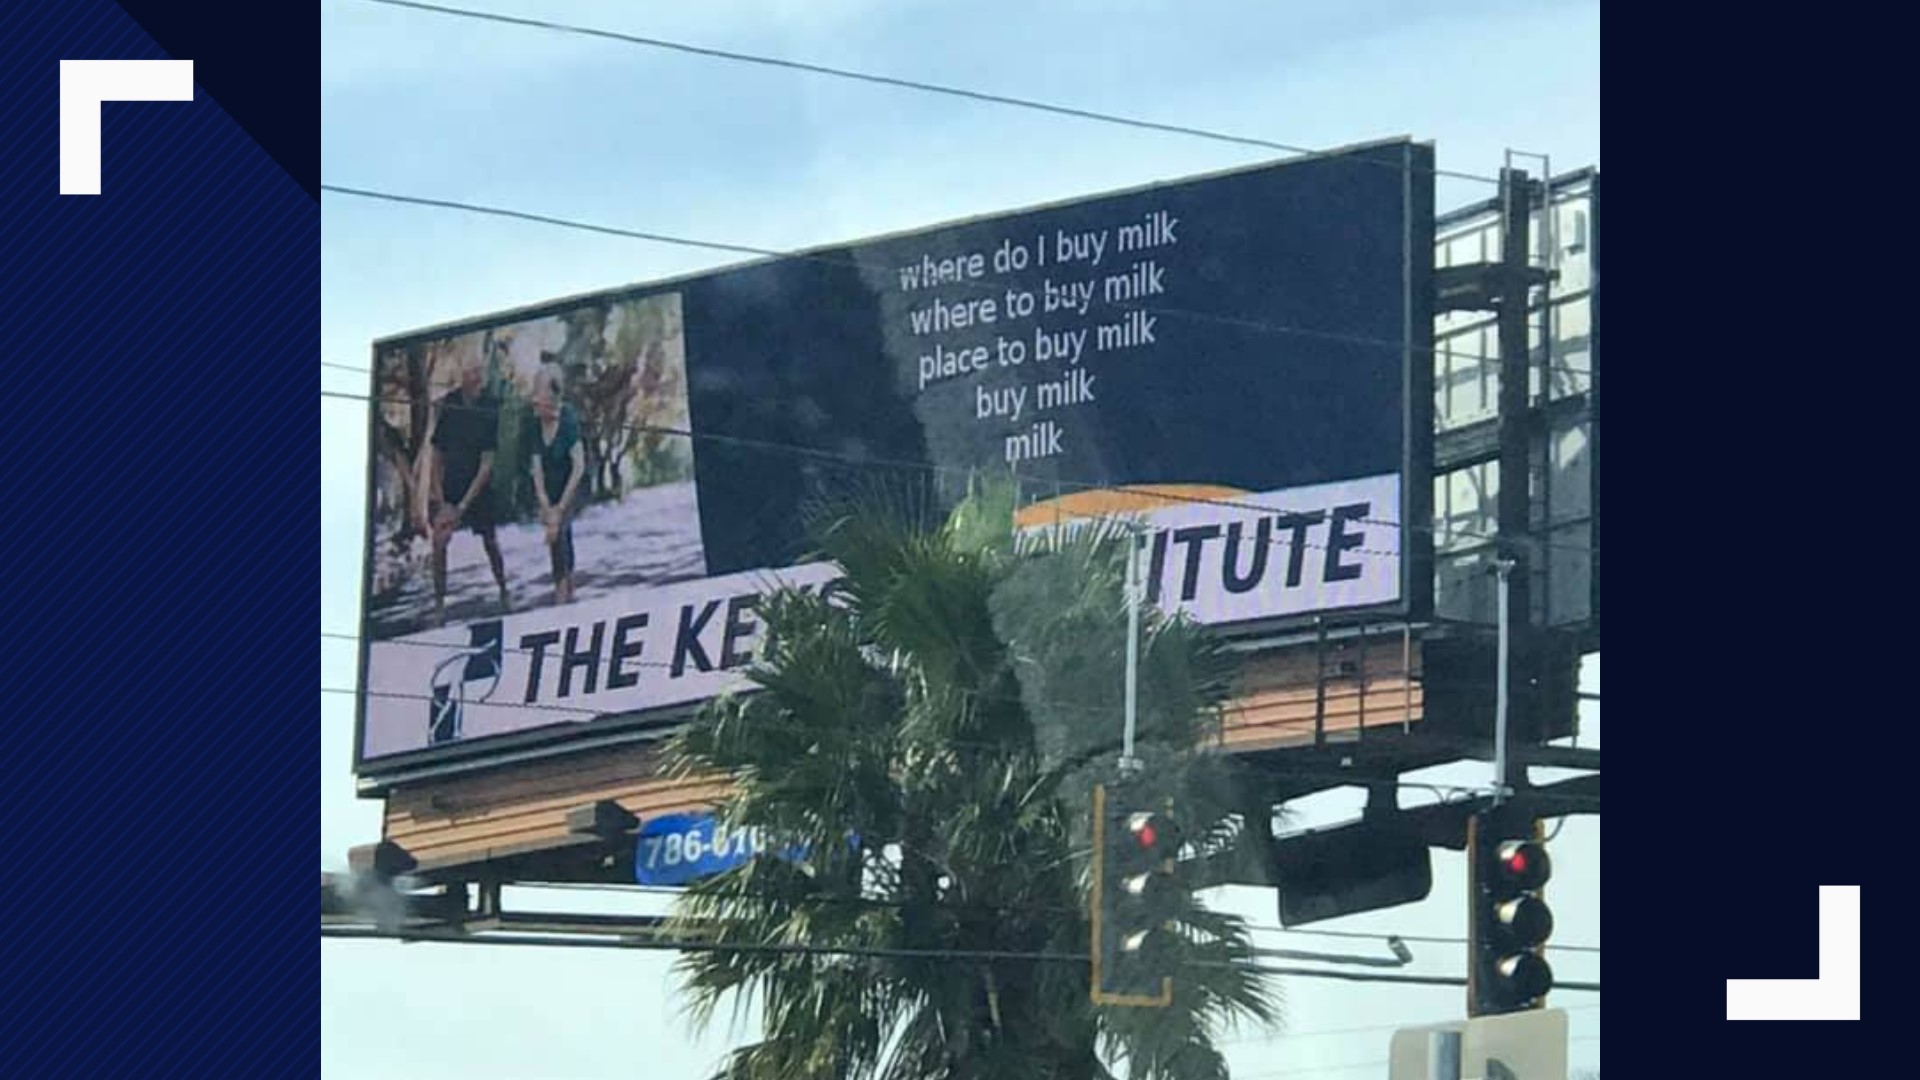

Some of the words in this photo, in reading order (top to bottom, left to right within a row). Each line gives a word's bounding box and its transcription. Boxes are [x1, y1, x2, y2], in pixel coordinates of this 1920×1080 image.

[899, 254, 985, 292] where
[993, 238, 1029, 273] do
[1037, 234, 1046, 266] I
[1056, 230, 1108, 266] buy
[1117, 210, 1179, 252] milk
[910, 298, 997, 335] where
[1005, 289, 1034, 319] to
[1044, 279, 1095, 315] buy
[1104, 261, 1165, 302] milk
[918, 345, 989, 390] place
[998, 336, 1026, 367] to
[1035, 327, 1087, 364] buy
[1097, 310, 1157, 350] milk
[976, 385, 1027, 422] buy
[1037, 368, 1096, 410] milk
[1004, 421, 1064, 462] milk
[519, 612, 649, 703] THE
[670, 577, 858, 680] KE
[1133, 502, 1372, 604] ITUTE
